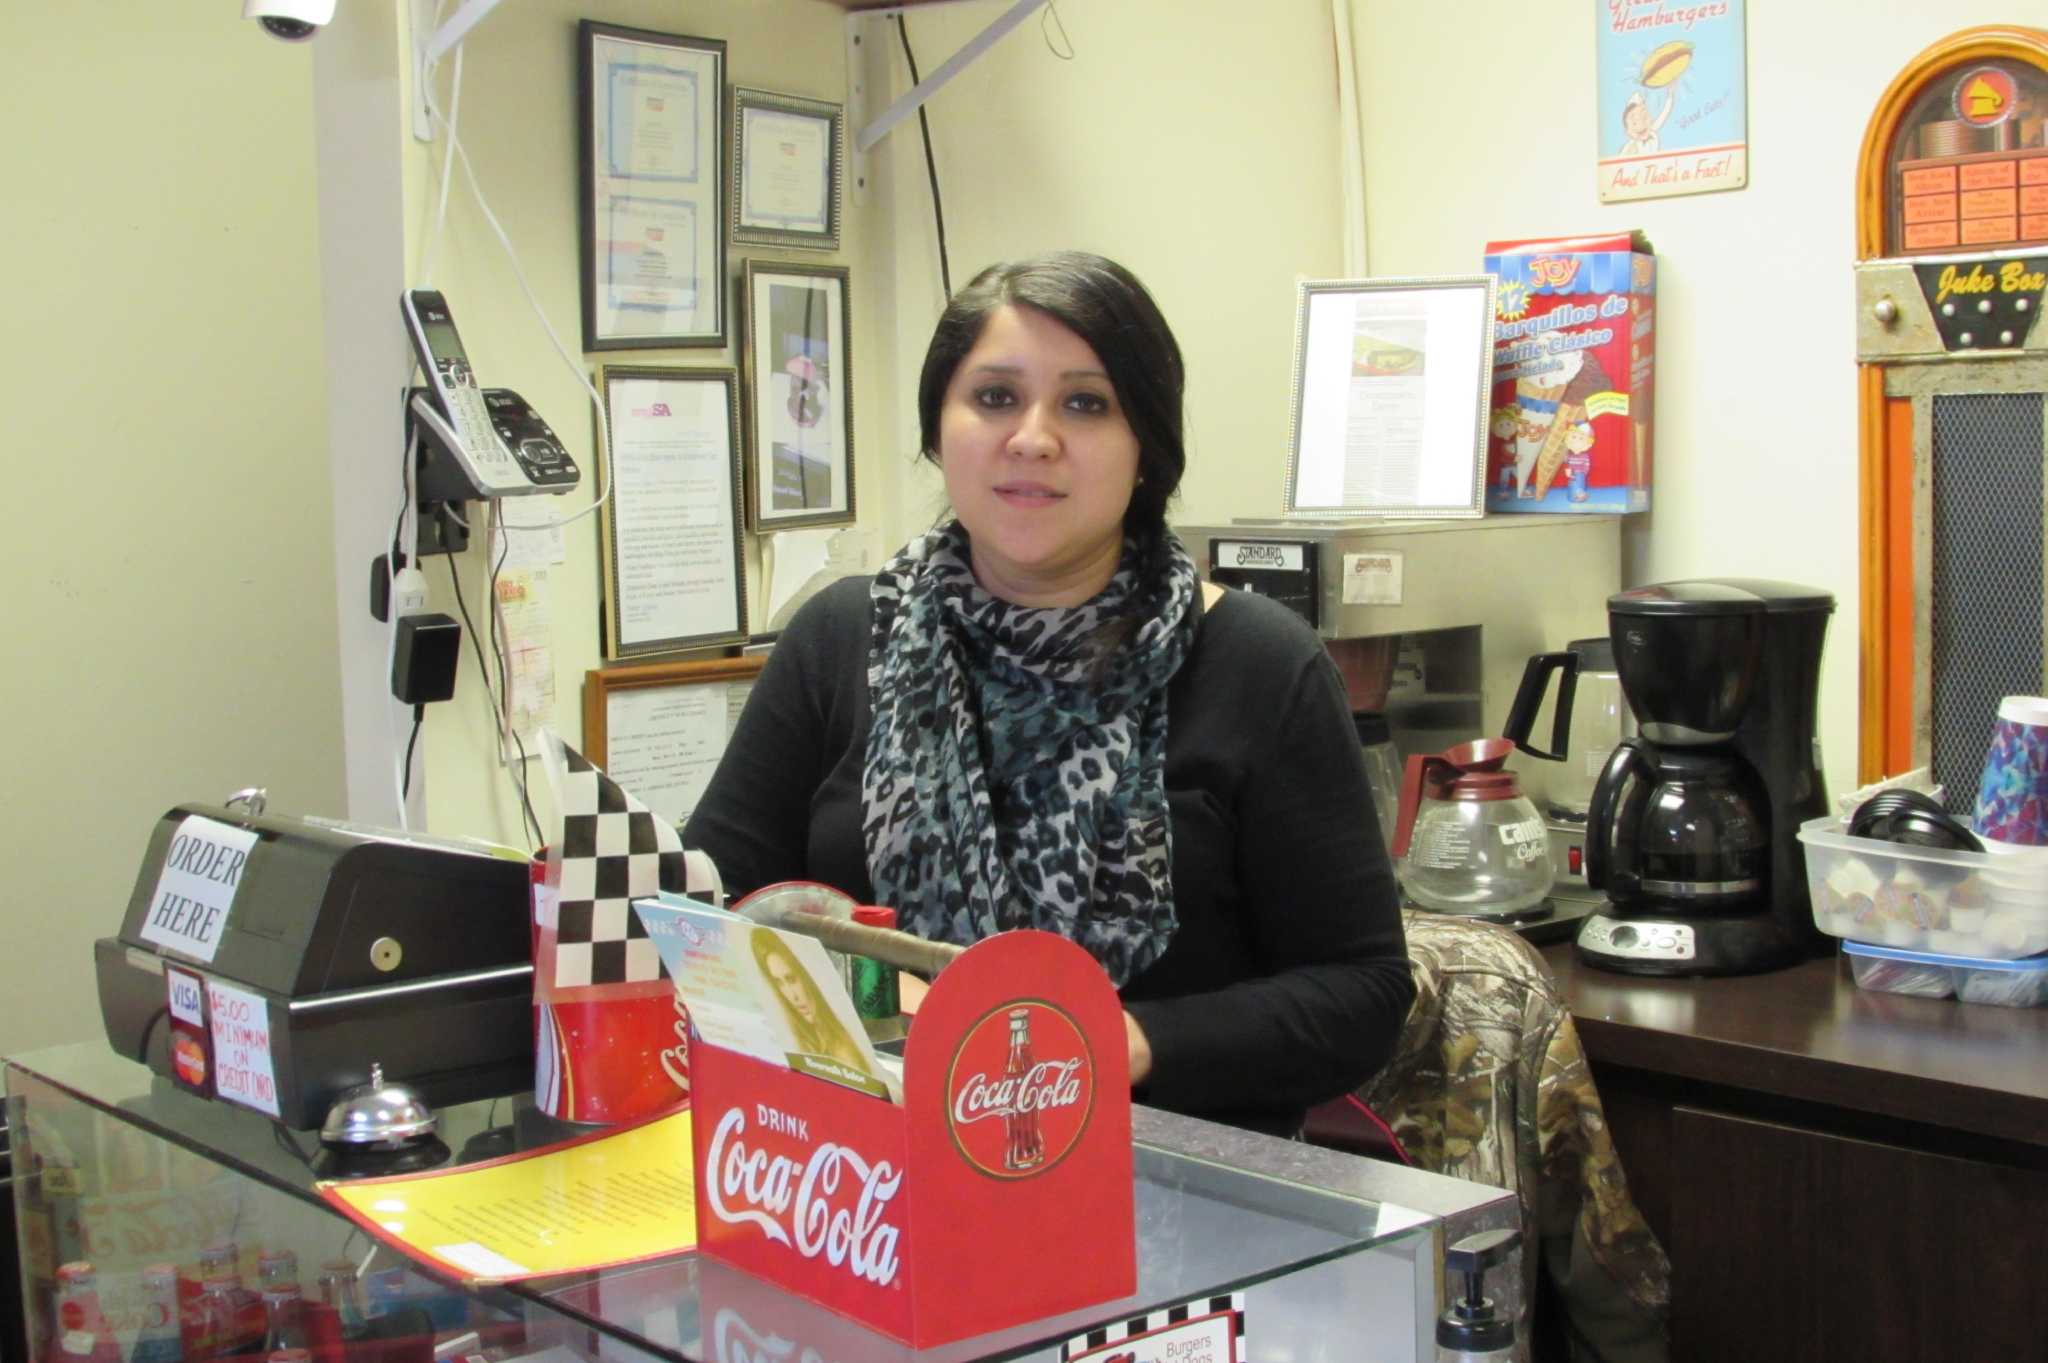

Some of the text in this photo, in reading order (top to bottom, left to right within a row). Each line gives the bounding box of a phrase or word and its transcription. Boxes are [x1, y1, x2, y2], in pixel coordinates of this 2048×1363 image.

[1612, 3, 1728, 32] Hamburgers
[1611, 154, 1731, 187] And That's a Fact!
[1528, 256, 1582, 288] Joy
[1936, 261, 2046, 304] Juke Box
[1600, 294, 1628, 318] de
[1236, 546, 1285, 567] STANDARD
[167, 833, 247, 887] ORDER
[153, 891, 220, 944] HERE
[173, 984, 199, 1010] VISA
[955, 1057, 1084, 1124] Coca-Cola
[757, 1103, 809, 1142] DRINK
[706, 1106, 904, 1287] Coca-Cola
[1166, 1335, 1212, 1358] Burgers
